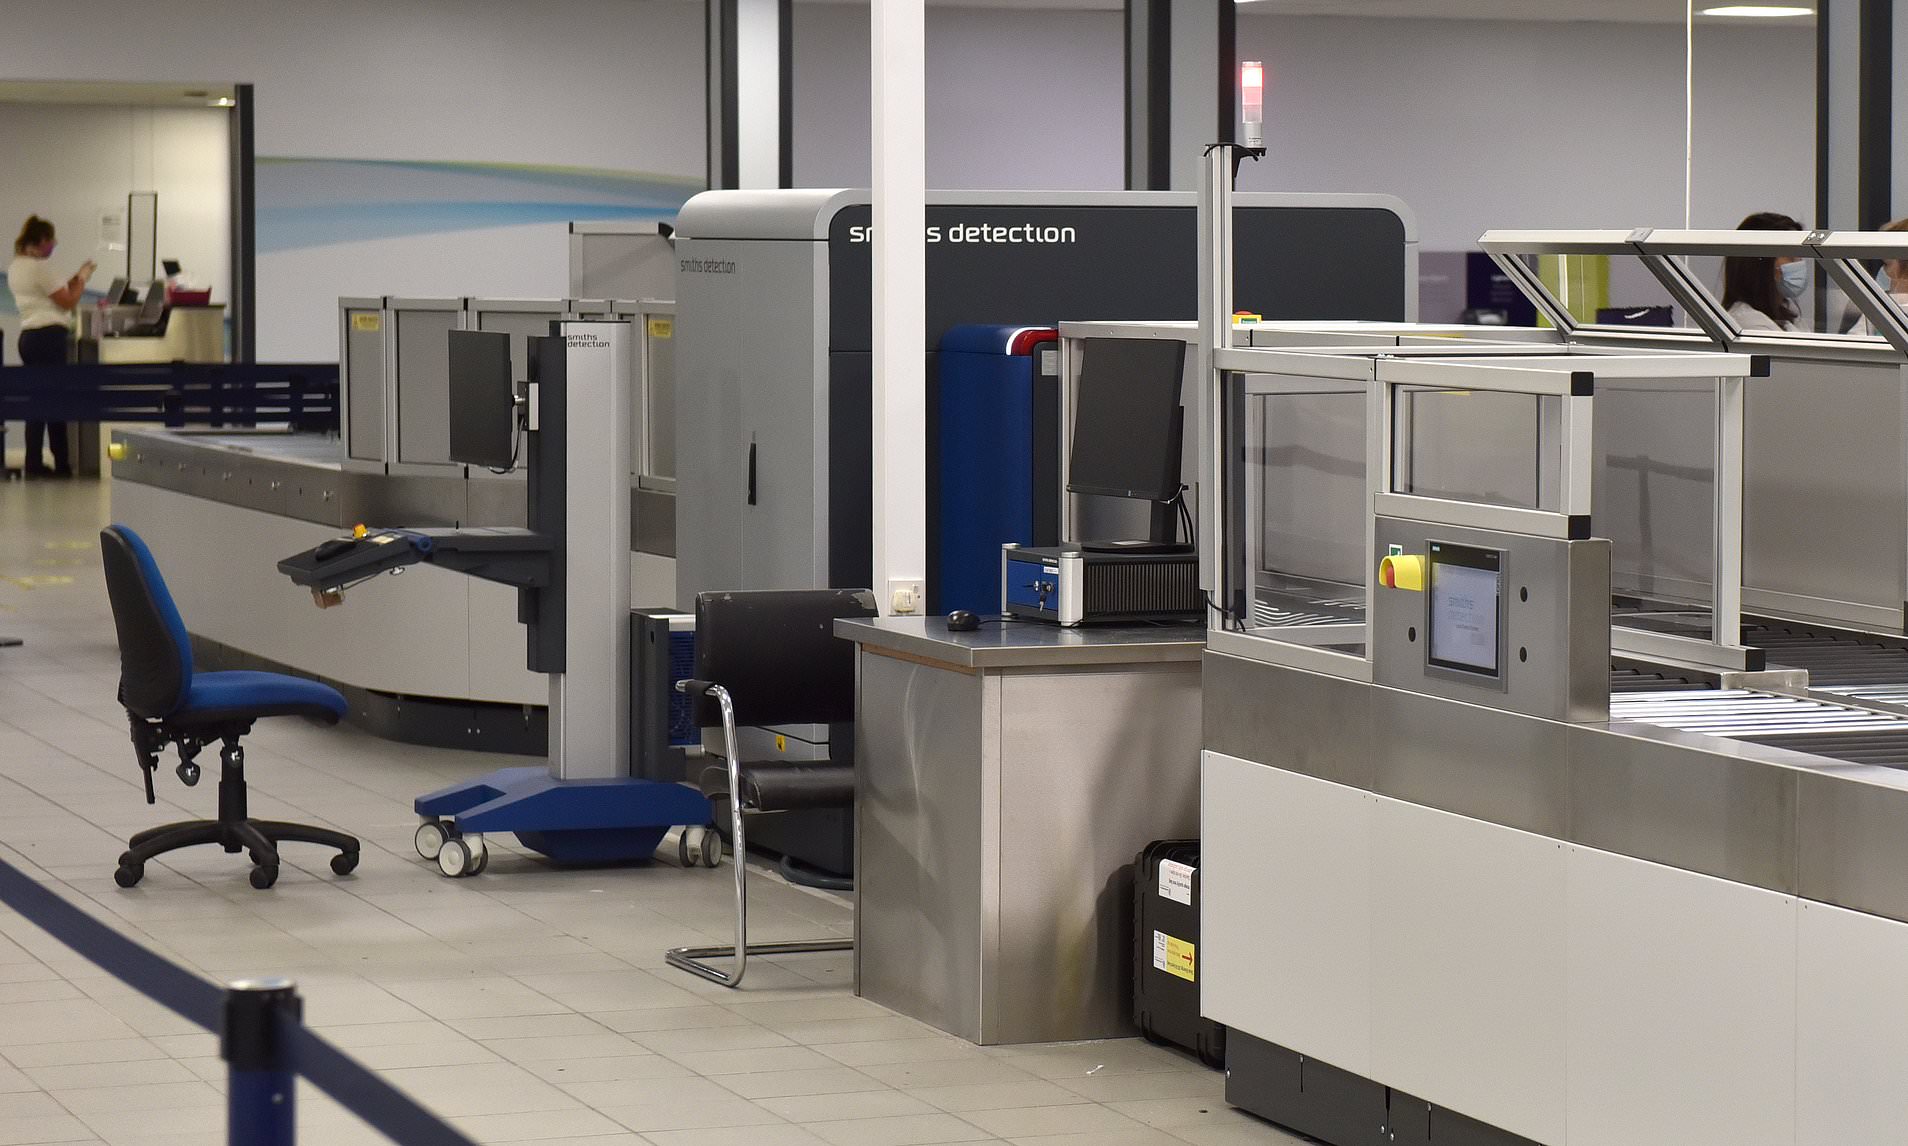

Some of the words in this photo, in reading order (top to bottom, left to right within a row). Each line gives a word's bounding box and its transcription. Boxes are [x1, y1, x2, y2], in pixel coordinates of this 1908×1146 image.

[948, 223, 1076, 243] detection
[680, 257, 703, 273] smiths
[703, 258, 736, 274] detection
[567, 333, 598, 341] smiths
[567, 340, 610, 348] detection
